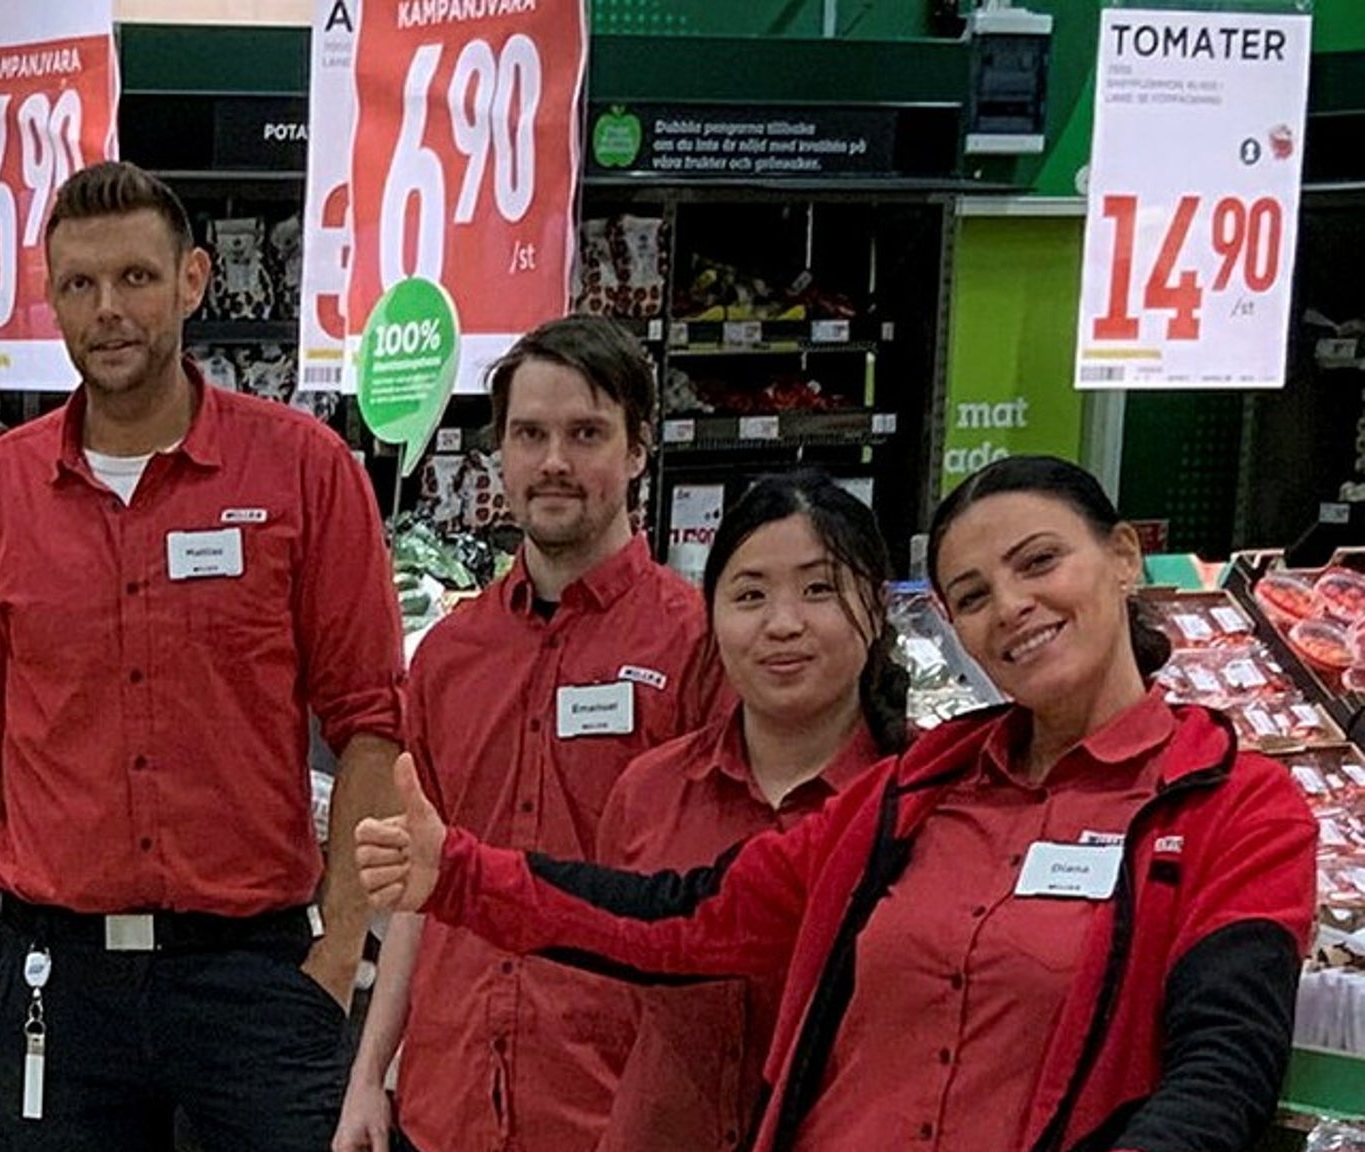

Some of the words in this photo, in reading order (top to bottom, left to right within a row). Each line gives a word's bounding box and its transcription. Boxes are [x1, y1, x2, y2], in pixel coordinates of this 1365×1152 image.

[1111, 25, 1286, 61] TOMATER
[264, 123, 308, 140] POTA
[374, 318, 440, 357] 100%
[956, 397, 1029, 428] mat
[571, 702, 619, 714] Emanuel
[1051, 862, 1090, 874] Diana
